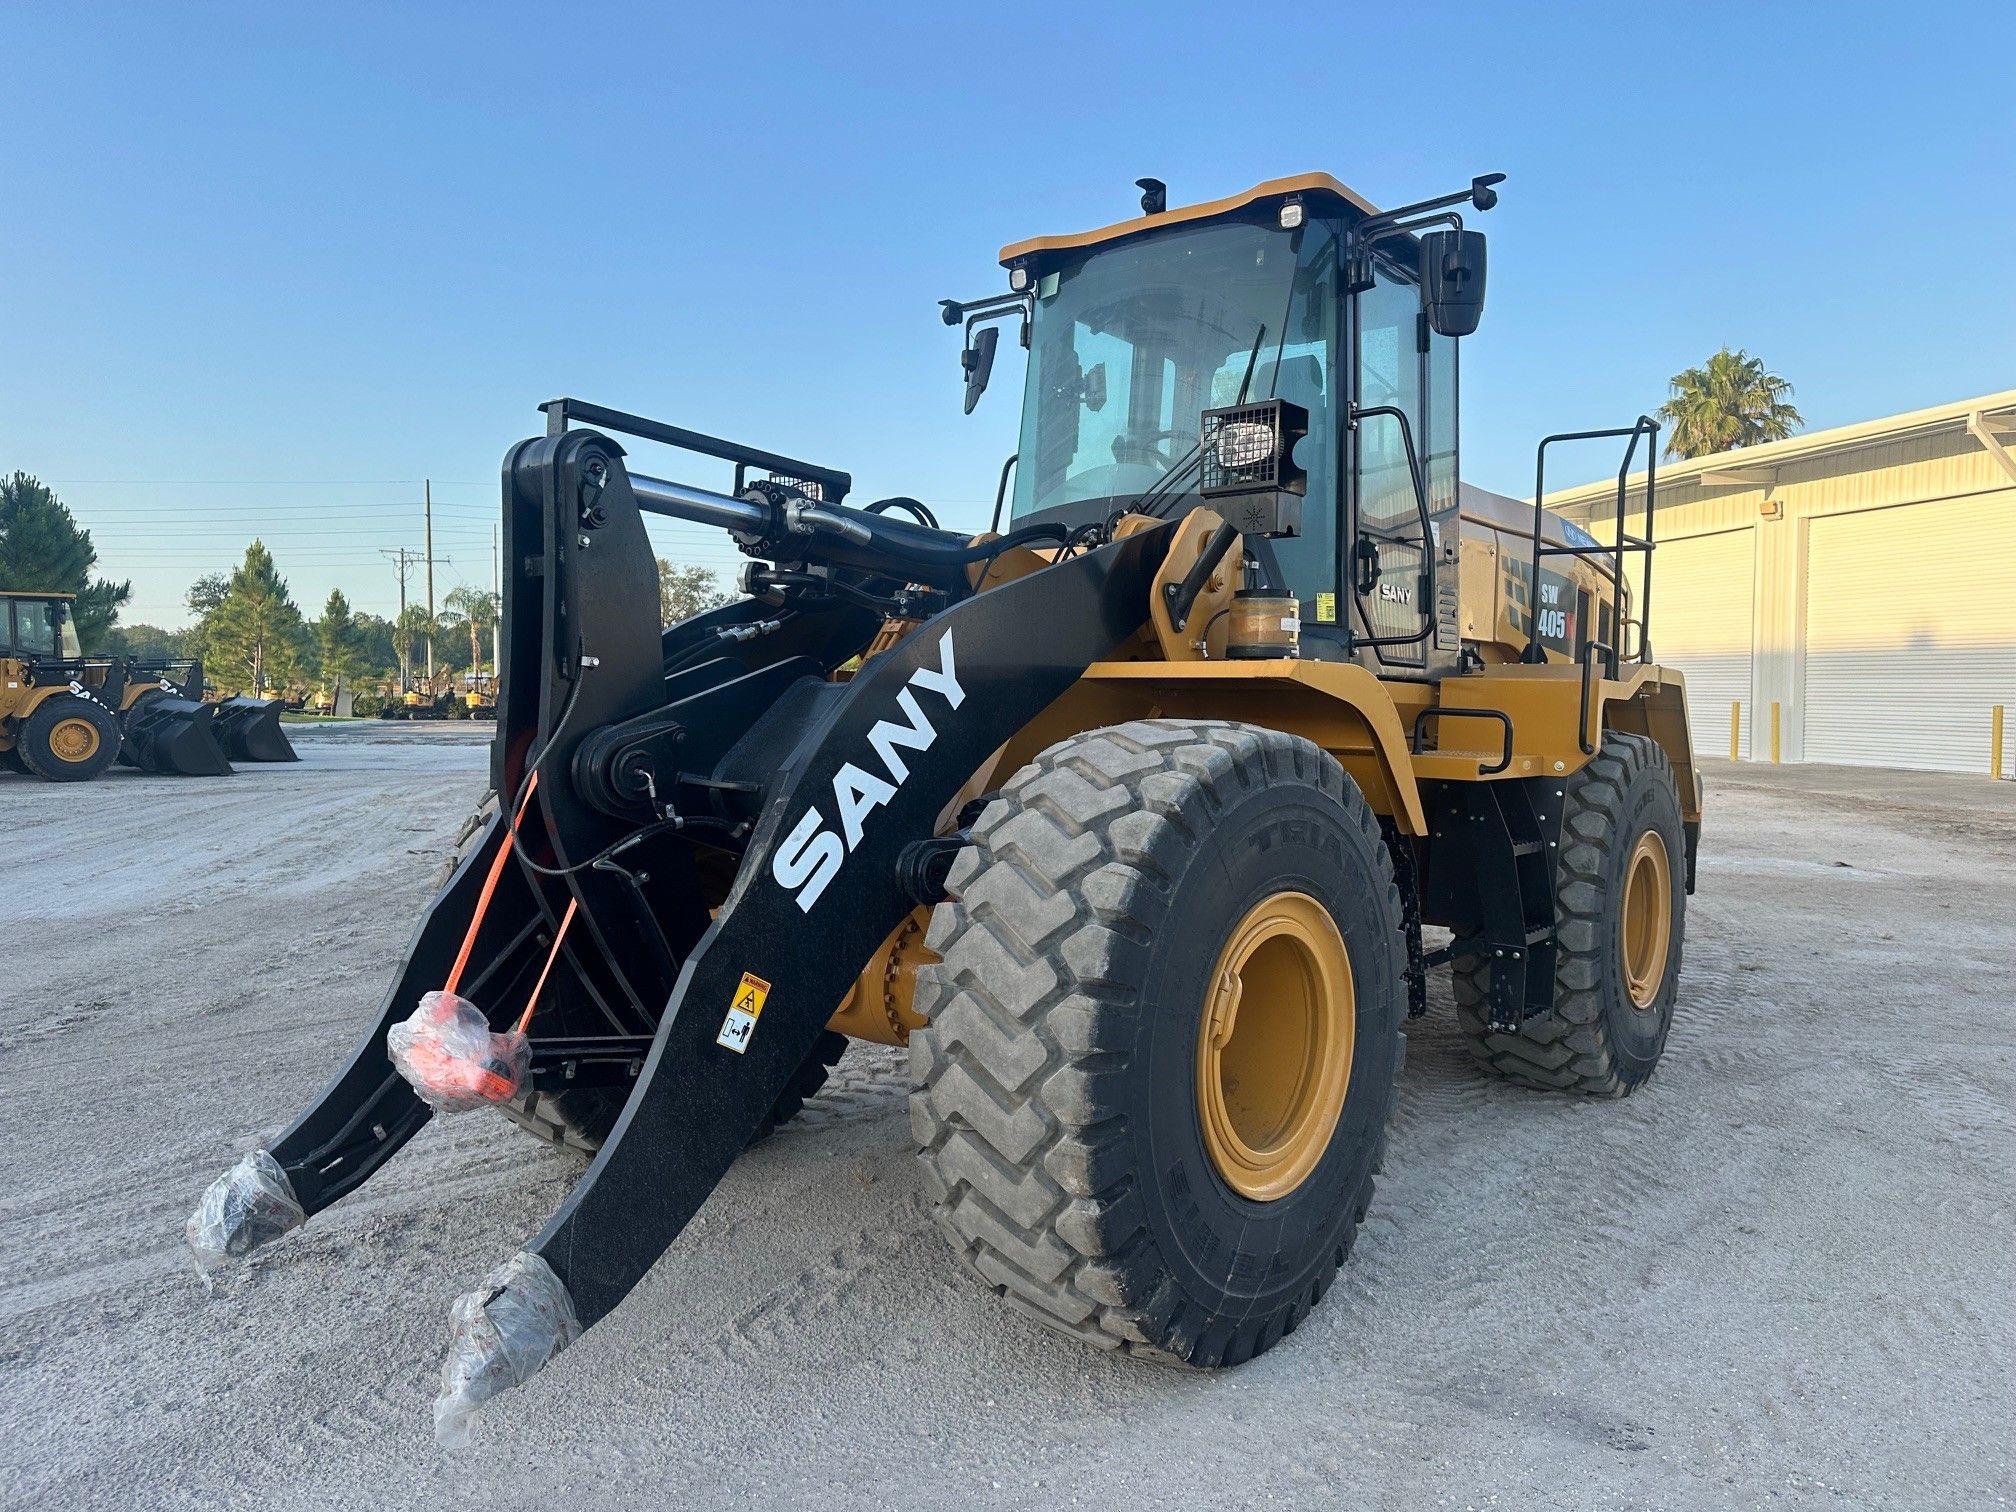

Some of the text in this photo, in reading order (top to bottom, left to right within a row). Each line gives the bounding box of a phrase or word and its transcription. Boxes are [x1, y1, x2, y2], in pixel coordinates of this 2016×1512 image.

[1380, 583, 1412, 606] SANY
[1541, 583, 1559, 604] SW
[773, 626, 966, 914] SANY
